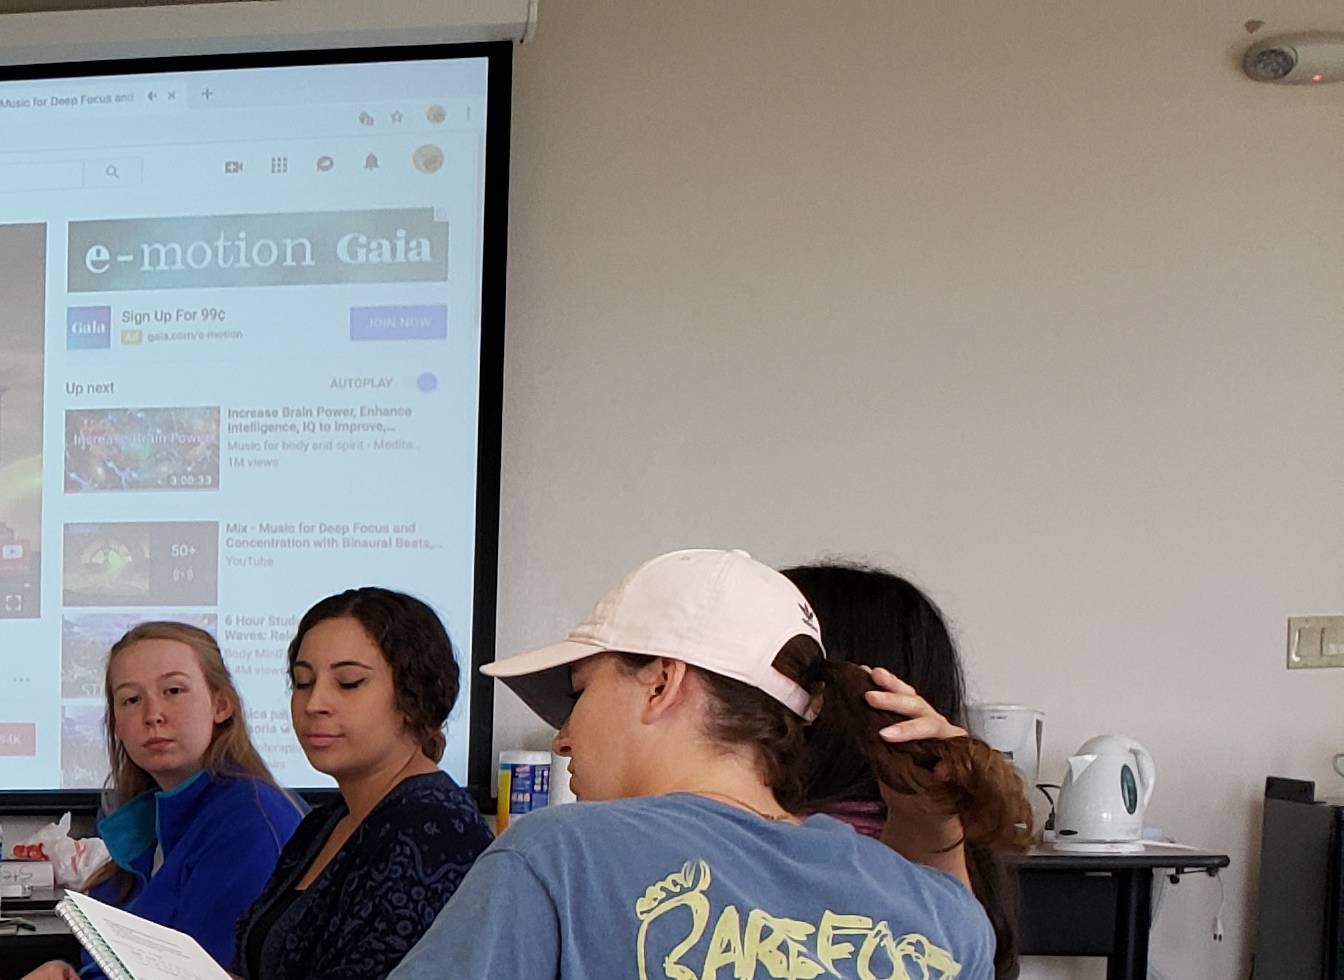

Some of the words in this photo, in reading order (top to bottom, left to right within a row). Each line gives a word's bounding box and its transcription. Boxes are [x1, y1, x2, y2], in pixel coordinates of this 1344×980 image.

[85, 230, 316, 274] e-motion
[335, 227, 433, 264] Gaia
[122, 309, 151, 326] Sign
[154, 309, 172, 325] Up
[175, 308, 198, 322] For
[329, 375, 394, 389] AUTOPLAY
[65, 381, 83, 397] Up
[86, 381, 115, 395] next
[227, 407, 278, 419] Increase
[281, 407, 313, 418] Brain
[359, 405, 412, 417] Enhance
[319, 421, 332, 432] to
[352, 522, 389, 533] Focus
[225, 537, 310, 549] Concentration
[171, 544, 197, 557] 50+
[235, 615, 265, 626] Hour
